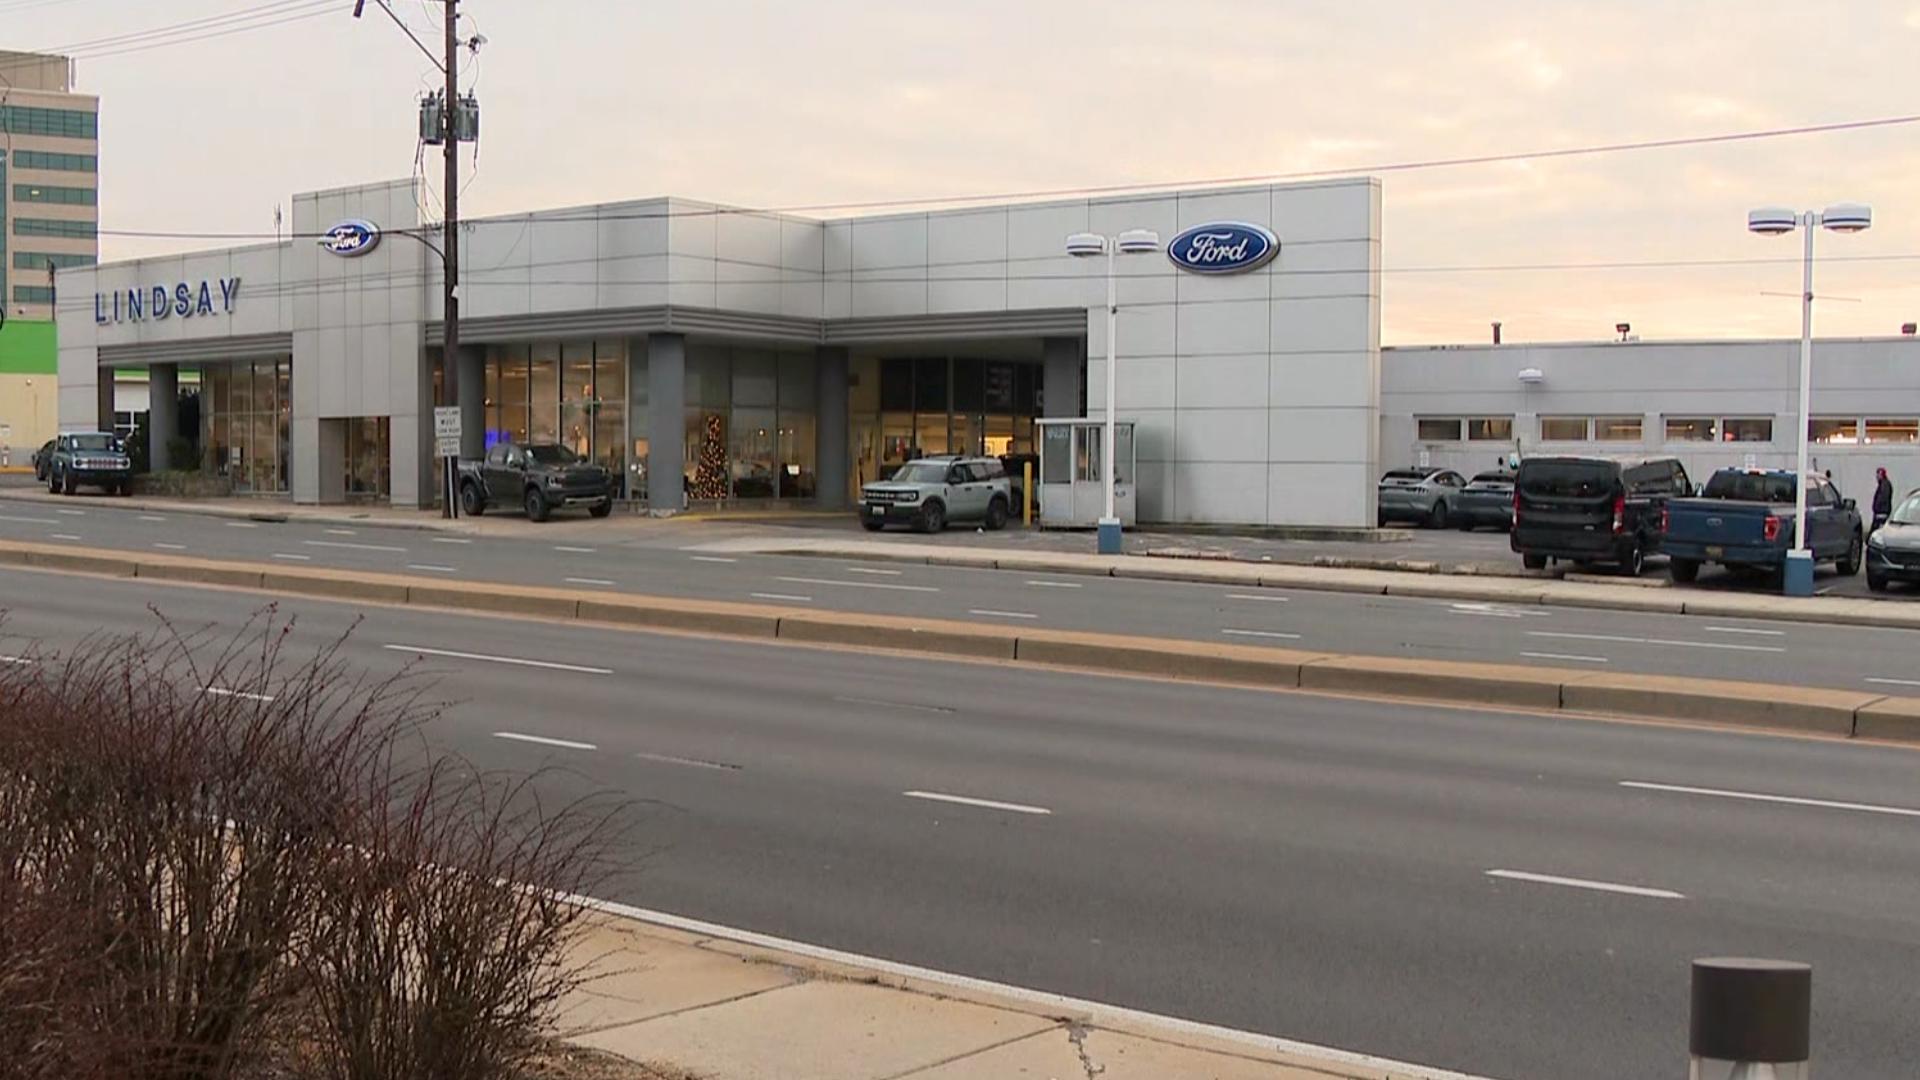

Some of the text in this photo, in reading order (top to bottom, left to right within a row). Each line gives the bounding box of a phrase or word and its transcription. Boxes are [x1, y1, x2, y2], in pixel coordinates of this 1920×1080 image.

[331, 227, 361, 248] Ford
[1186, 231, 1249, 262] Ford
[95, 277, 239, 324] LINDSAY
